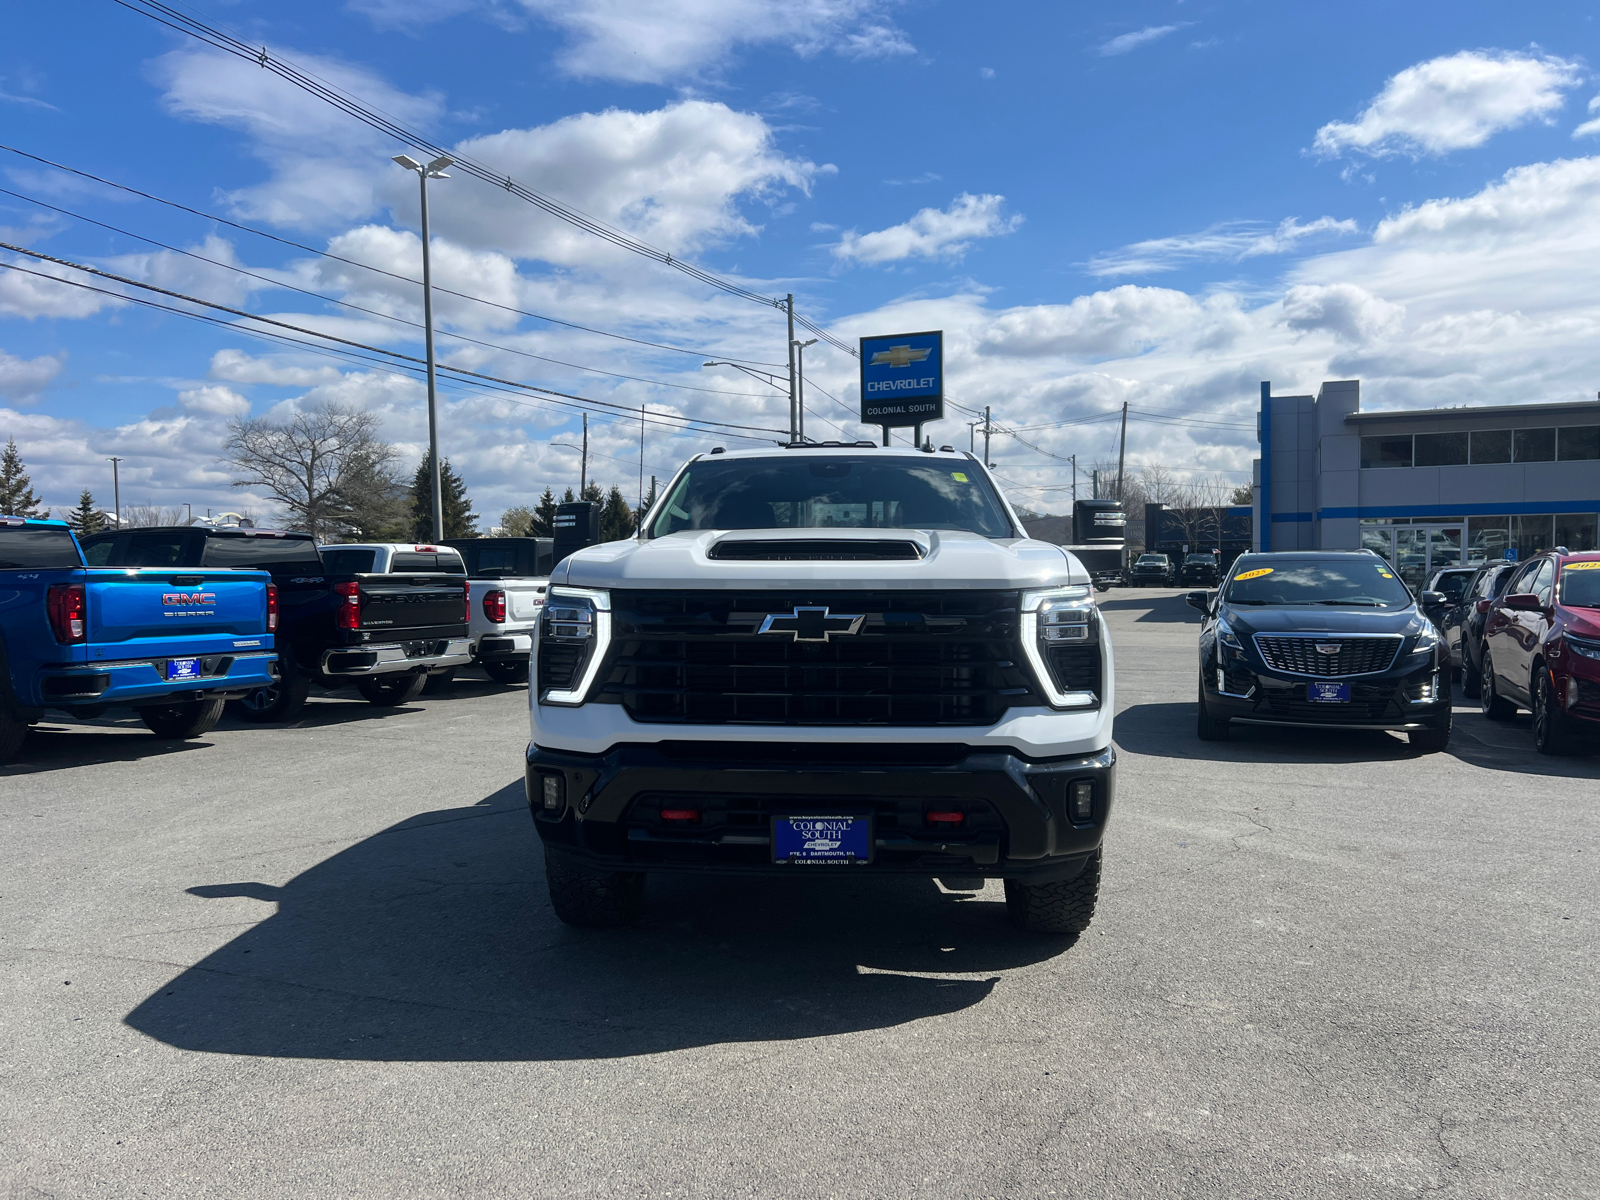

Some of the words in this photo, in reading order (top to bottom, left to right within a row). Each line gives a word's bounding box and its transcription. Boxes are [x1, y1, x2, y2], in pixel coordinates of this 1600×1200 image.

[867, 377, 935, 392] CHEVROLET
[867, 406, 906, 415] COLONIAL
[908, 403, 936, 413] SOUTH
[1243, 569, 1267, 579] 2025
[163, 593, 216, 606] GMC
[793, 822, 850, 830] COLONIAL
[802, 830, 841, 839] SOUTH
